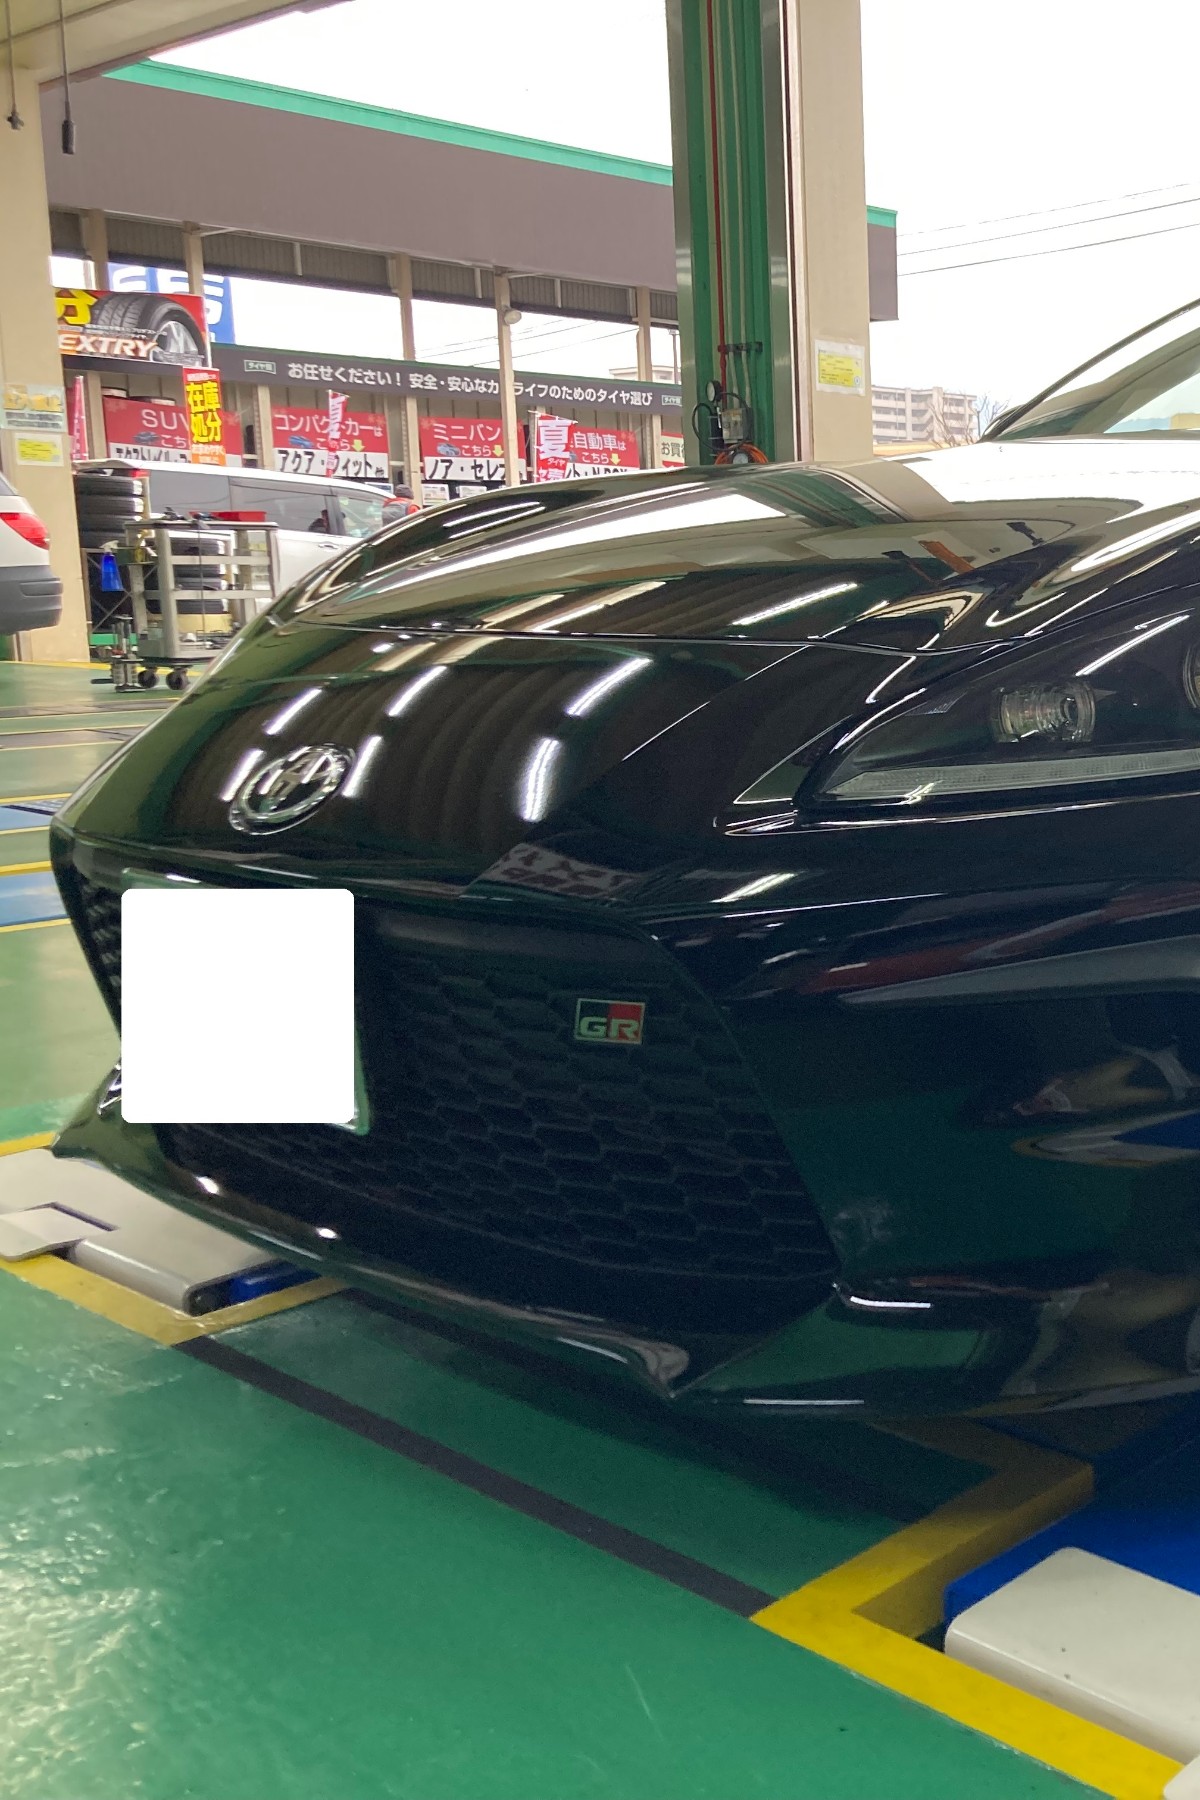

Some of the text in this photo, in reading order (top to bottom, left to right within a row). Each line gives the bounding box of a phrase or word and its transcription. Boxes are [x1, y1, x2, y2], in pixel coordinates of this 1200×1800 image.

[409, 373, 653, 406] 安全・安心なカライフのためのタイヤ選び
[433, 423, 502, 442] ミニバン
[537, 418, 570, 460] 夏
[572, 431, 627, 452] 自動車は
[461, 444, 492, 457] こちら
[581, 451, 610, 464] こちら
[579, 1016, 640, 1041] GR
